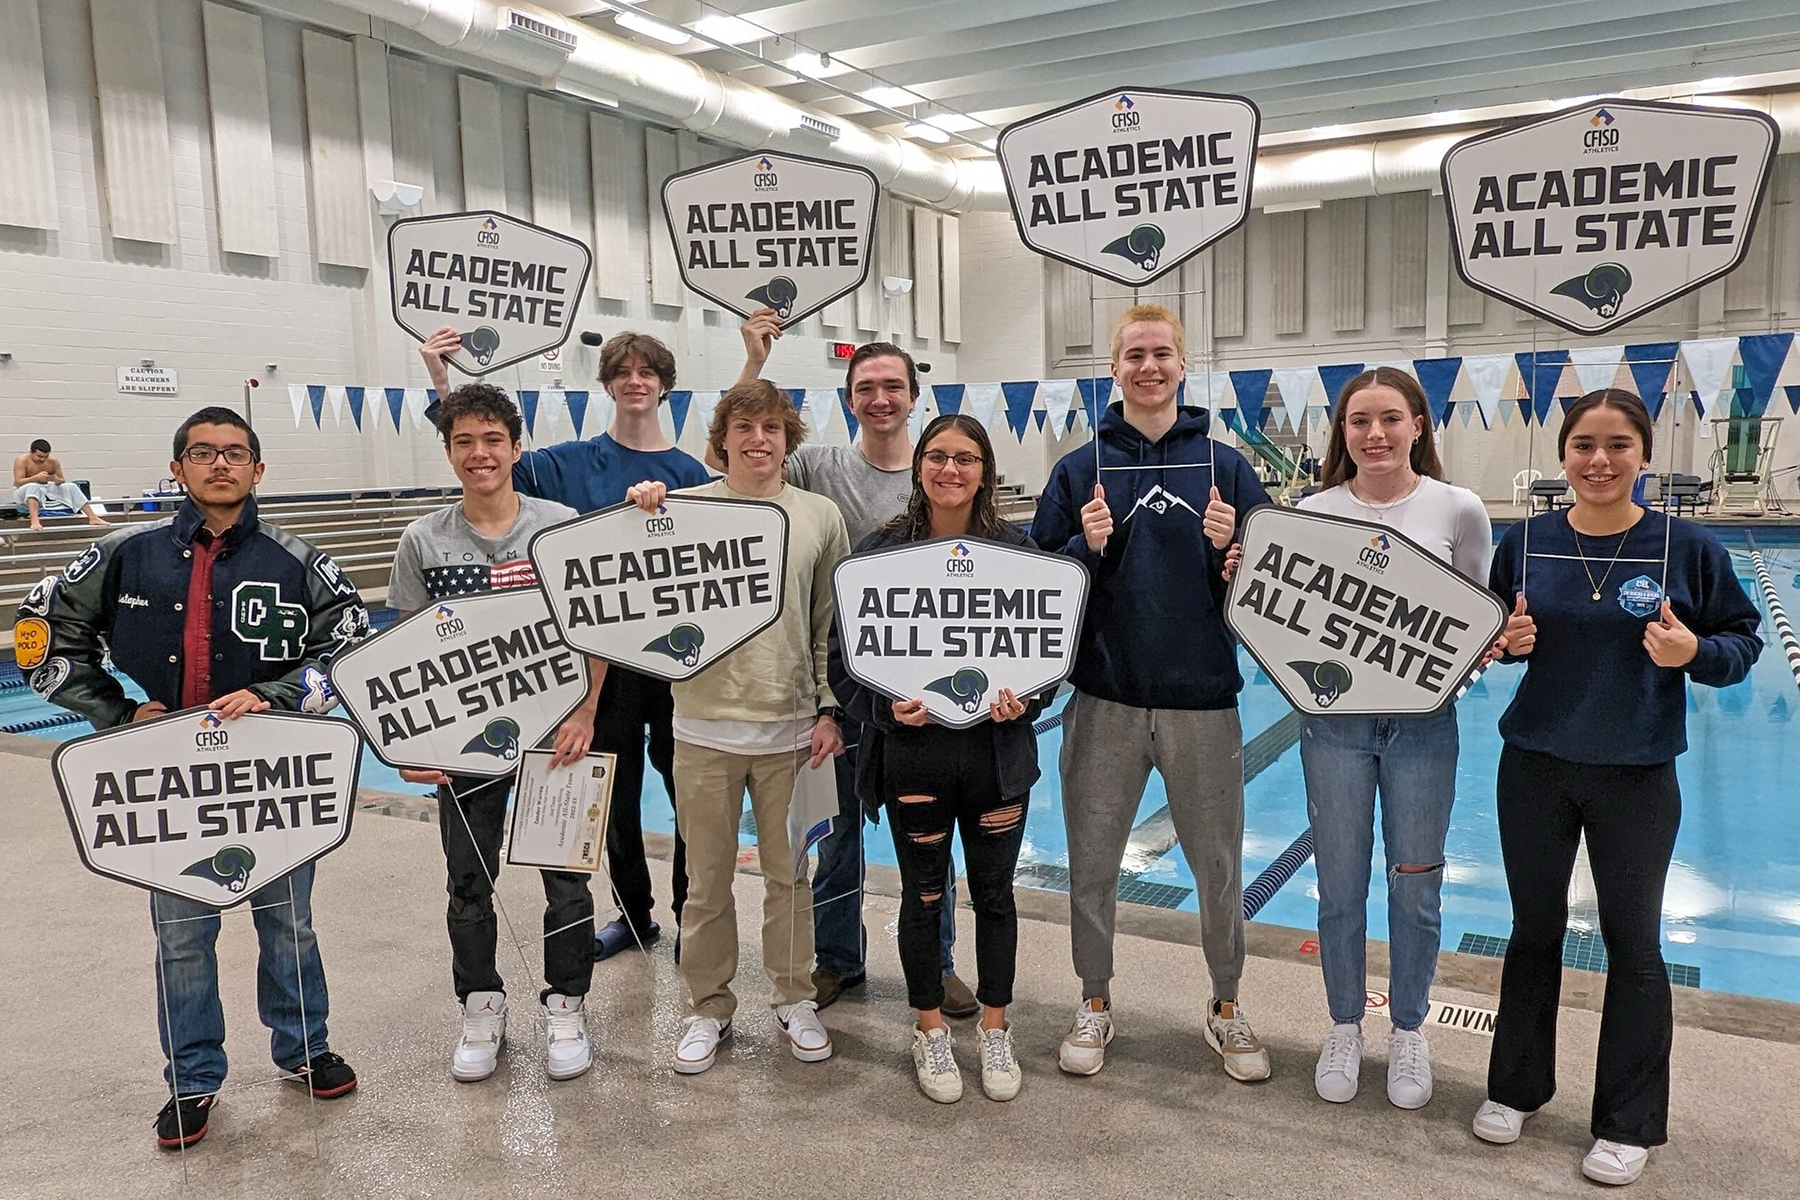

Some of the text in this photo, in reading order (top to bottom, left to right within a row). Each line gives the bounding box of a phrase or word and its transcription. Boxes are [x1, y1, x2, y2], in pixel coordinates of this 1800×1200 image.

[1112, 111, 1140, 128] CFISD
[1583, 146, 1619, 154] ATHLETICS
[1584, 129, 1619, 148] CFISD
[1028, 132, 1234, 188] ACADEMIC
[754, 173, 778, 187] CFISD
[1472, 155, 1738, 214] ACADEMIC
[1030, 172, 1238, 227] ALL STATE
[687, 200, 856, 233] ACADEMIC
[1469, 205, 1736, 260] ALL STATE
[478, 231, 499, 244] CFISD
[688, 237, 859, 269] ALL STATE
[406, 249, 567, 294] ACADEMIC
[401, 282, 564, 327] ALL STATE
[646, 517, 674, 533] CFISD
[443, 550, 517, 563] TOMM
[564, 536, 766, 591] ACADEMIC
[947, 559, 974, 573] CFISD
[1356, 560, 1385, 575] ATHLETICS
[1358, 546, 1390, 569] CFISD
[568, 573, 772, 629] ALL STATE
[858, 588, 1061, 620] ACADEMIC
[1254, 543, 1470, 655] ACADEMIC
[436, 618, 464, 638] CFISD
[440, 630, 467, 643] ATHLETICS
[855, 626, 1063, 658] ALL STATE
[1237, 579, 1453, 693] ALL STATE
[18, 641, 37, 649] POLO
[365, 618, 566, 711] ACADEMIC
[378, 651, 578, 746] ALL STATE
[196, 731, 228, 747] CFISD
[196, 744, 229, 752] ATHLETICS
[92, 753, 334, 807] ACADEMIC
[93, 792, 338, 849] ALL STATE
[558, 820, 567, 848] Academic
[1437, 1006, 1498, 1032] DIVIN
